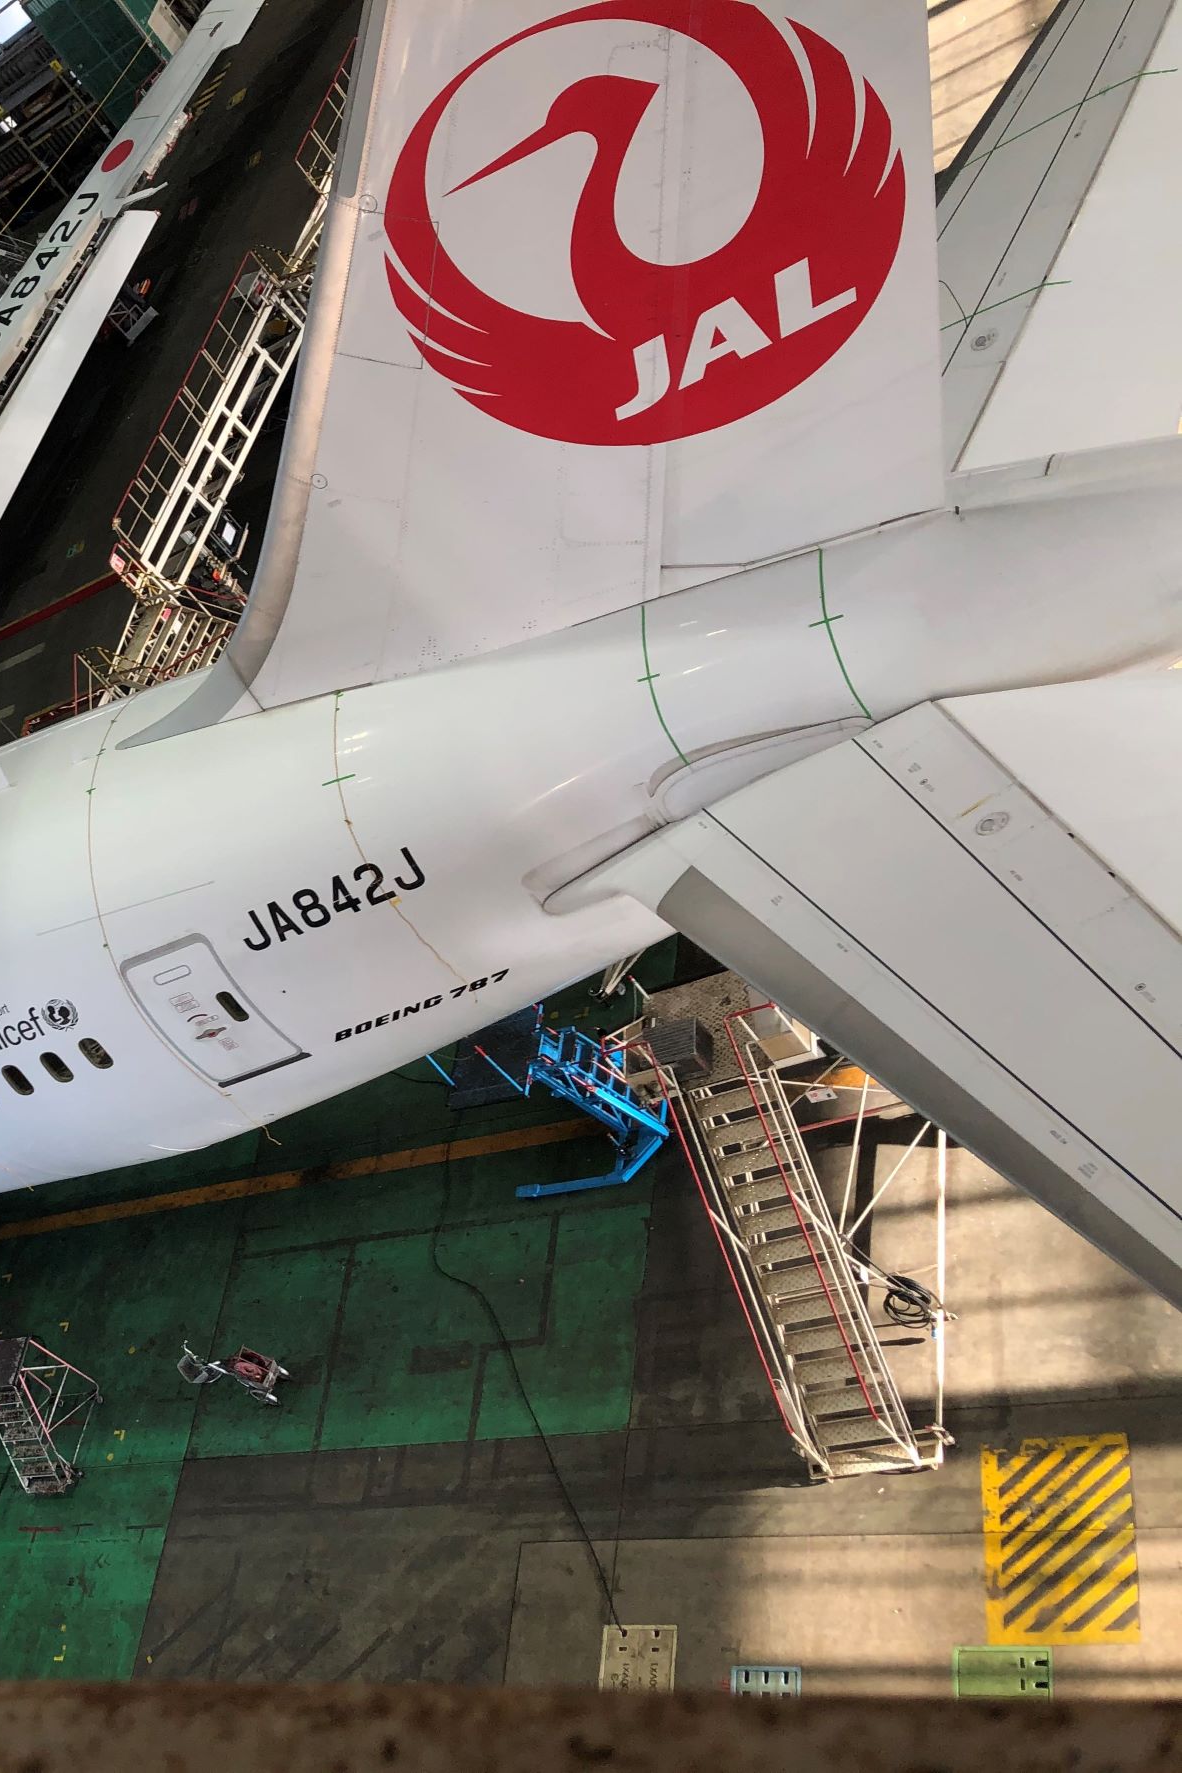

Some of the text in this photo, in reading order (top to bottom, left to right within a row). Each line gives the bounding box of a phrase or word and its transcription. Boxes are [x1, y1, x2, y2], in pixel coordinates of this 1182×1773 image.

[615, 257, 857, 421] JAL
[243, 847, 425, 951] JA842J
[335, 968, 510, 1042] BOEING 787
